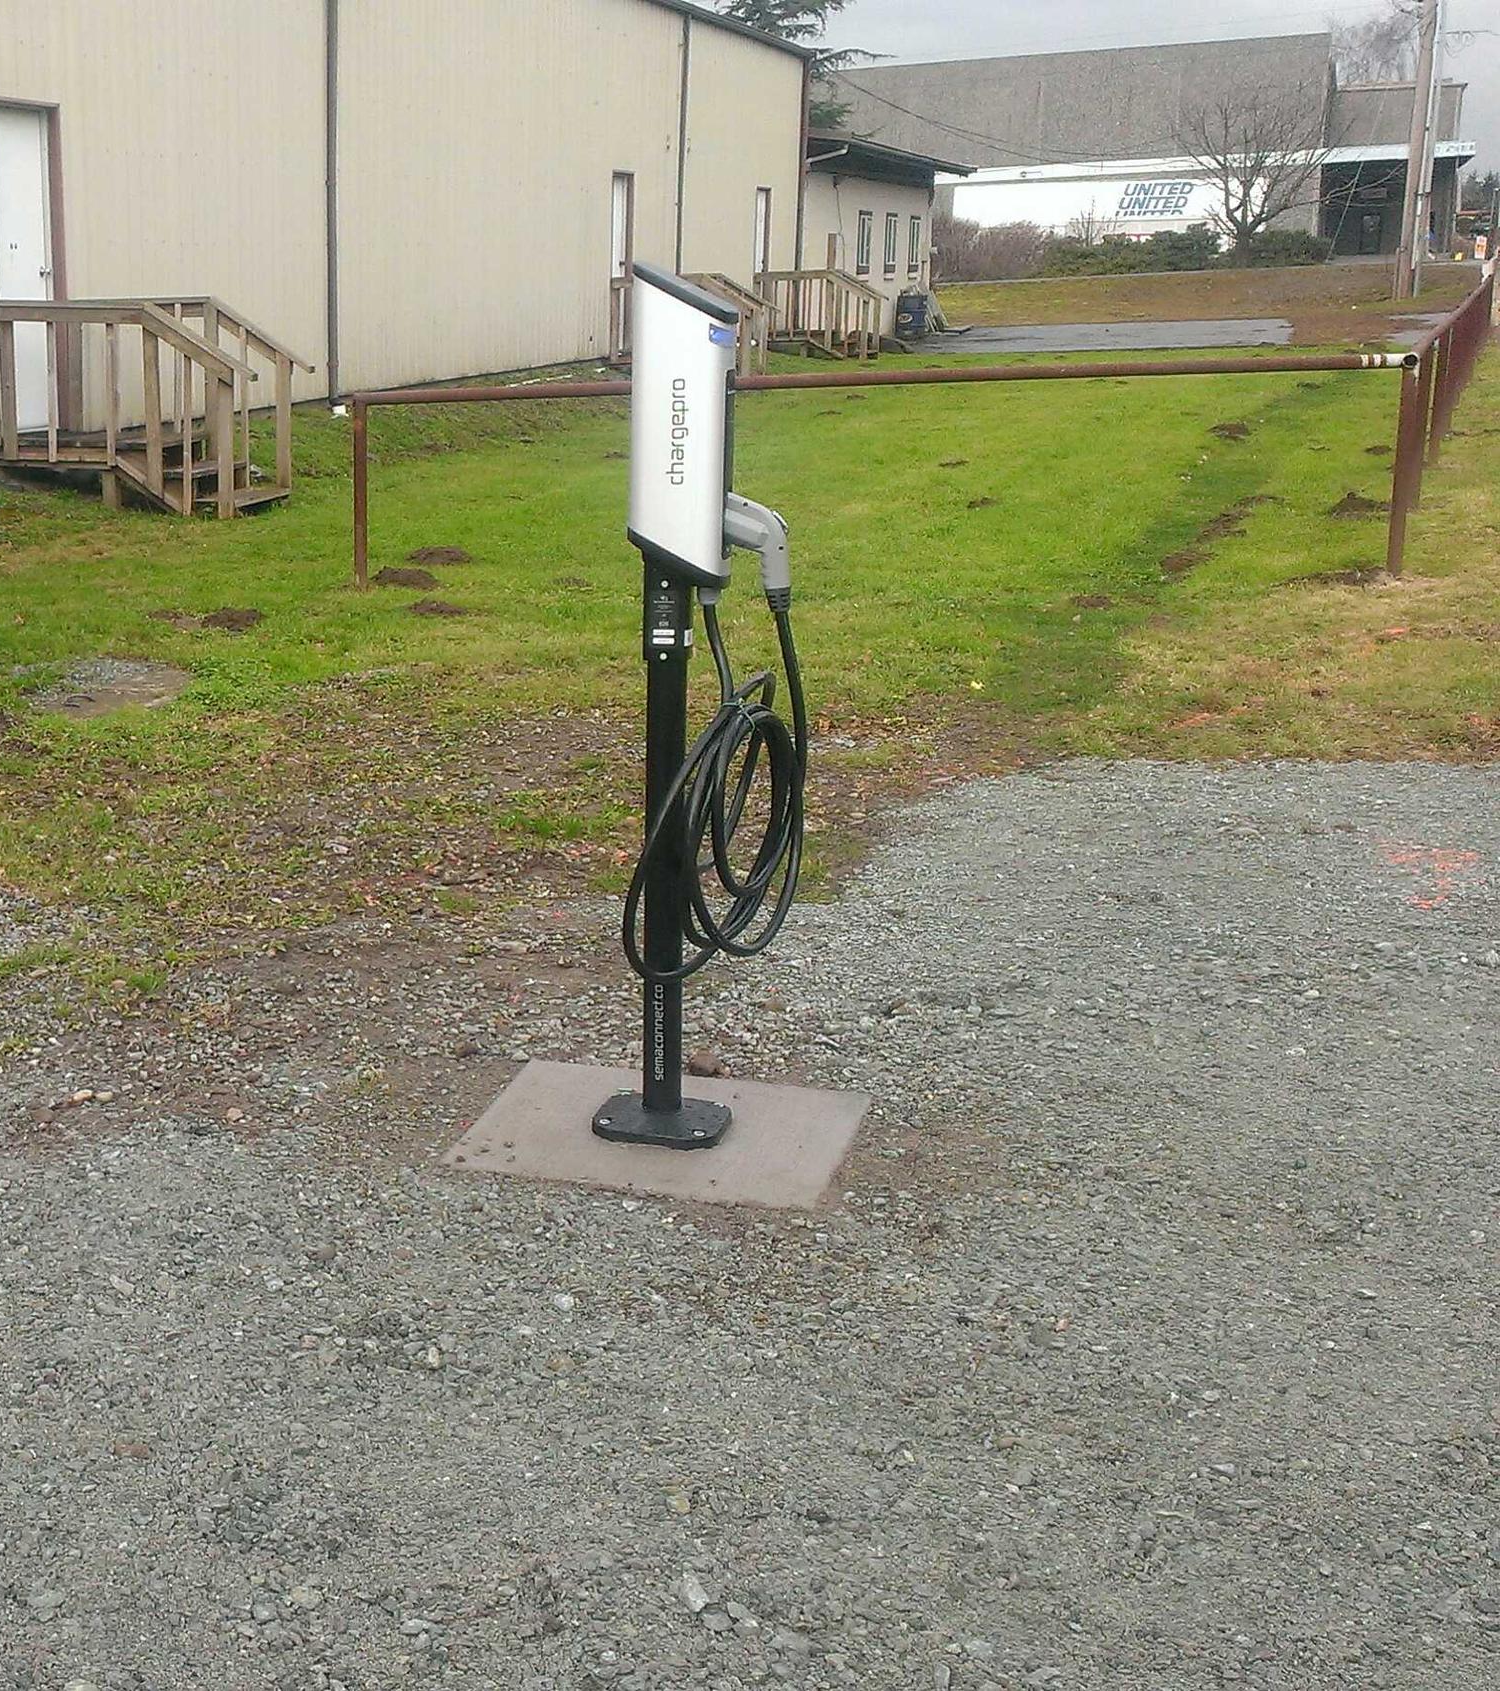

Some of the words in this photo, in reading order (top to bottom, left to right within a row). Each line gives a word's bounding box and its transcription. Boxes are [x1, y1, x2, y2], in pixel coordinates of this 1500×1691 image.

[1123, 181, 1194, 196] UNITED
[1118, 196, 1188, 210] UNITED
[666, 377, 689, 486] chargepro
